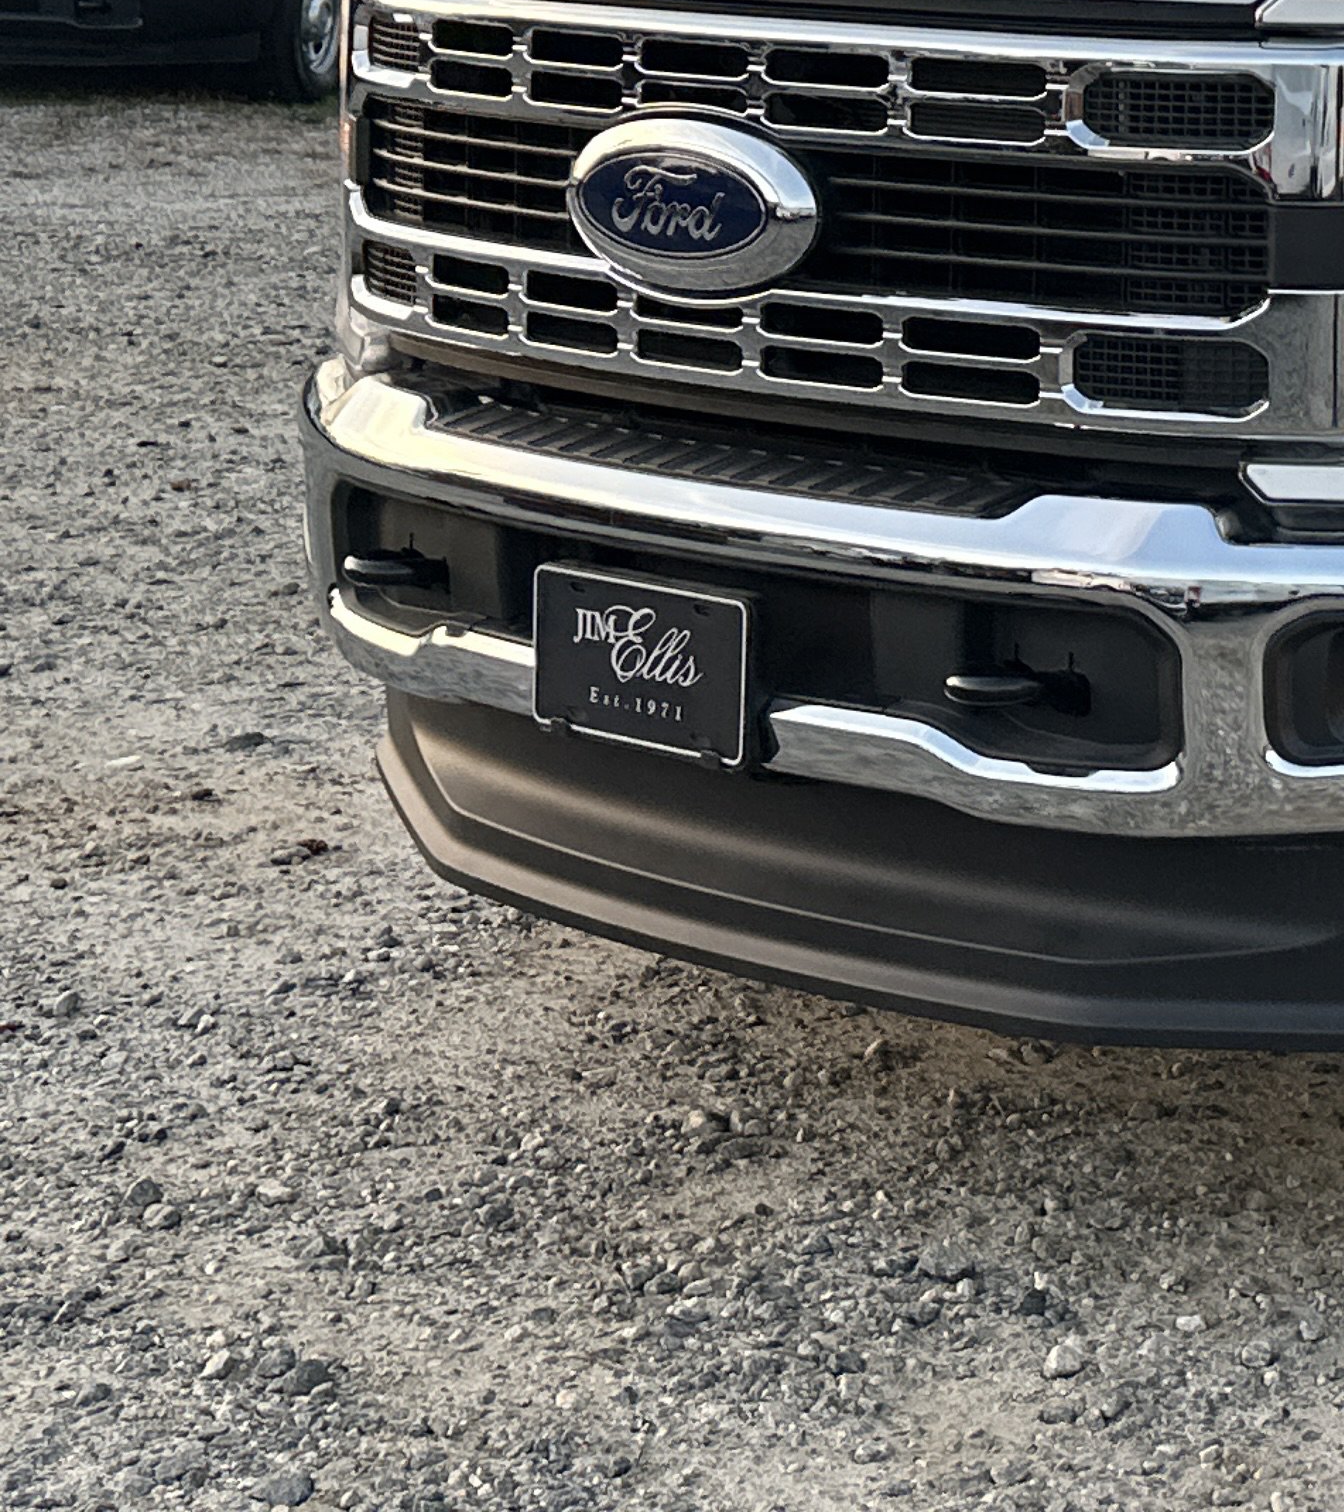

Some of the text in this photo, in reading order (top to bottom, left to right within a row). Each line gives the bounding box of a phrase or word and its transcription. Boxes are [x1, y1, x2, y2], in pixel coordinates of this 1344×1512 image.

[611, 164, 726, 241] Ford
[572, 604, 704, 687] JIM Ellis
